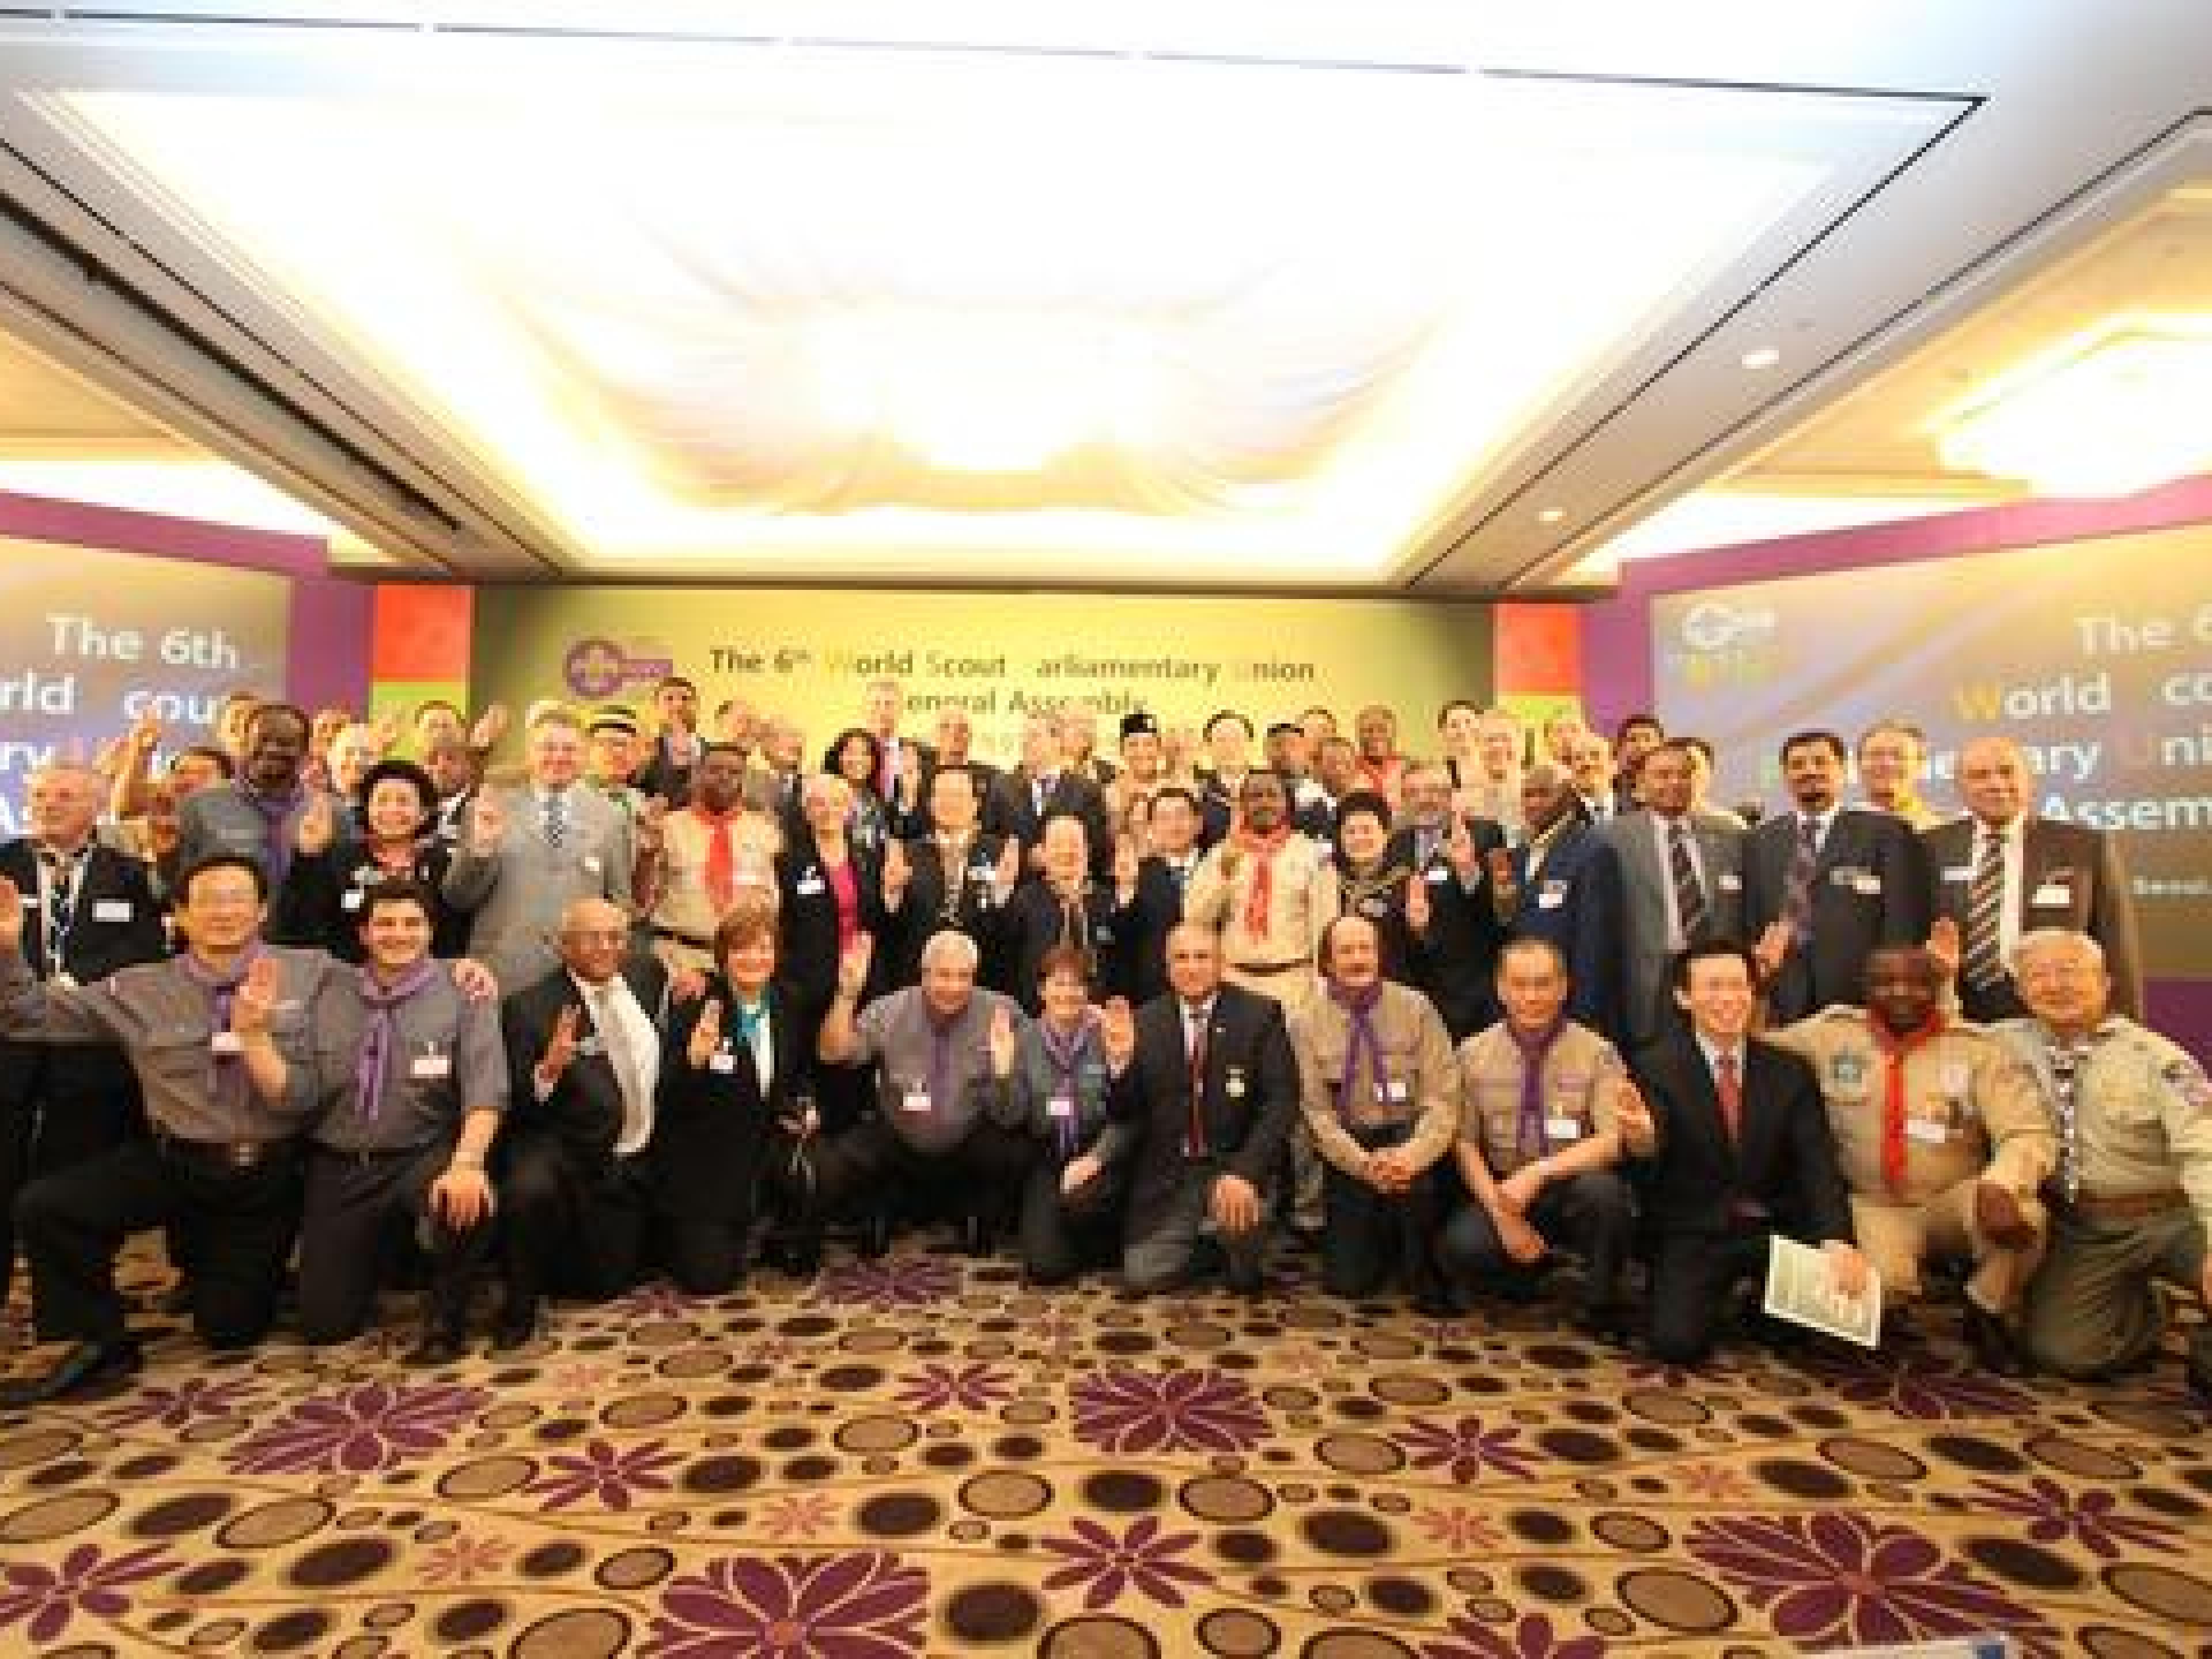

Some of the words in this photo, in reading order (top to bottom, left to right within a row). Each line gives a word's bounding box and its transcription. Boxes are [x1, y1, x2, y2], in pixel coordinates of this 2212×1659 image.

[46, 613, 143, 661] The
[159, 627, 240, 671] 6th
[2074, 612, 2173, 656] The
[710, 646, 763, 674] The
[1035, 651, 1222, 688] arliamentary
[1234, 654, 1316, 681] nion
[904, 688, 997, 713] enral
[1008, 689, 1147, 715] Assbl
[1954, 669, 2112, 725] World
